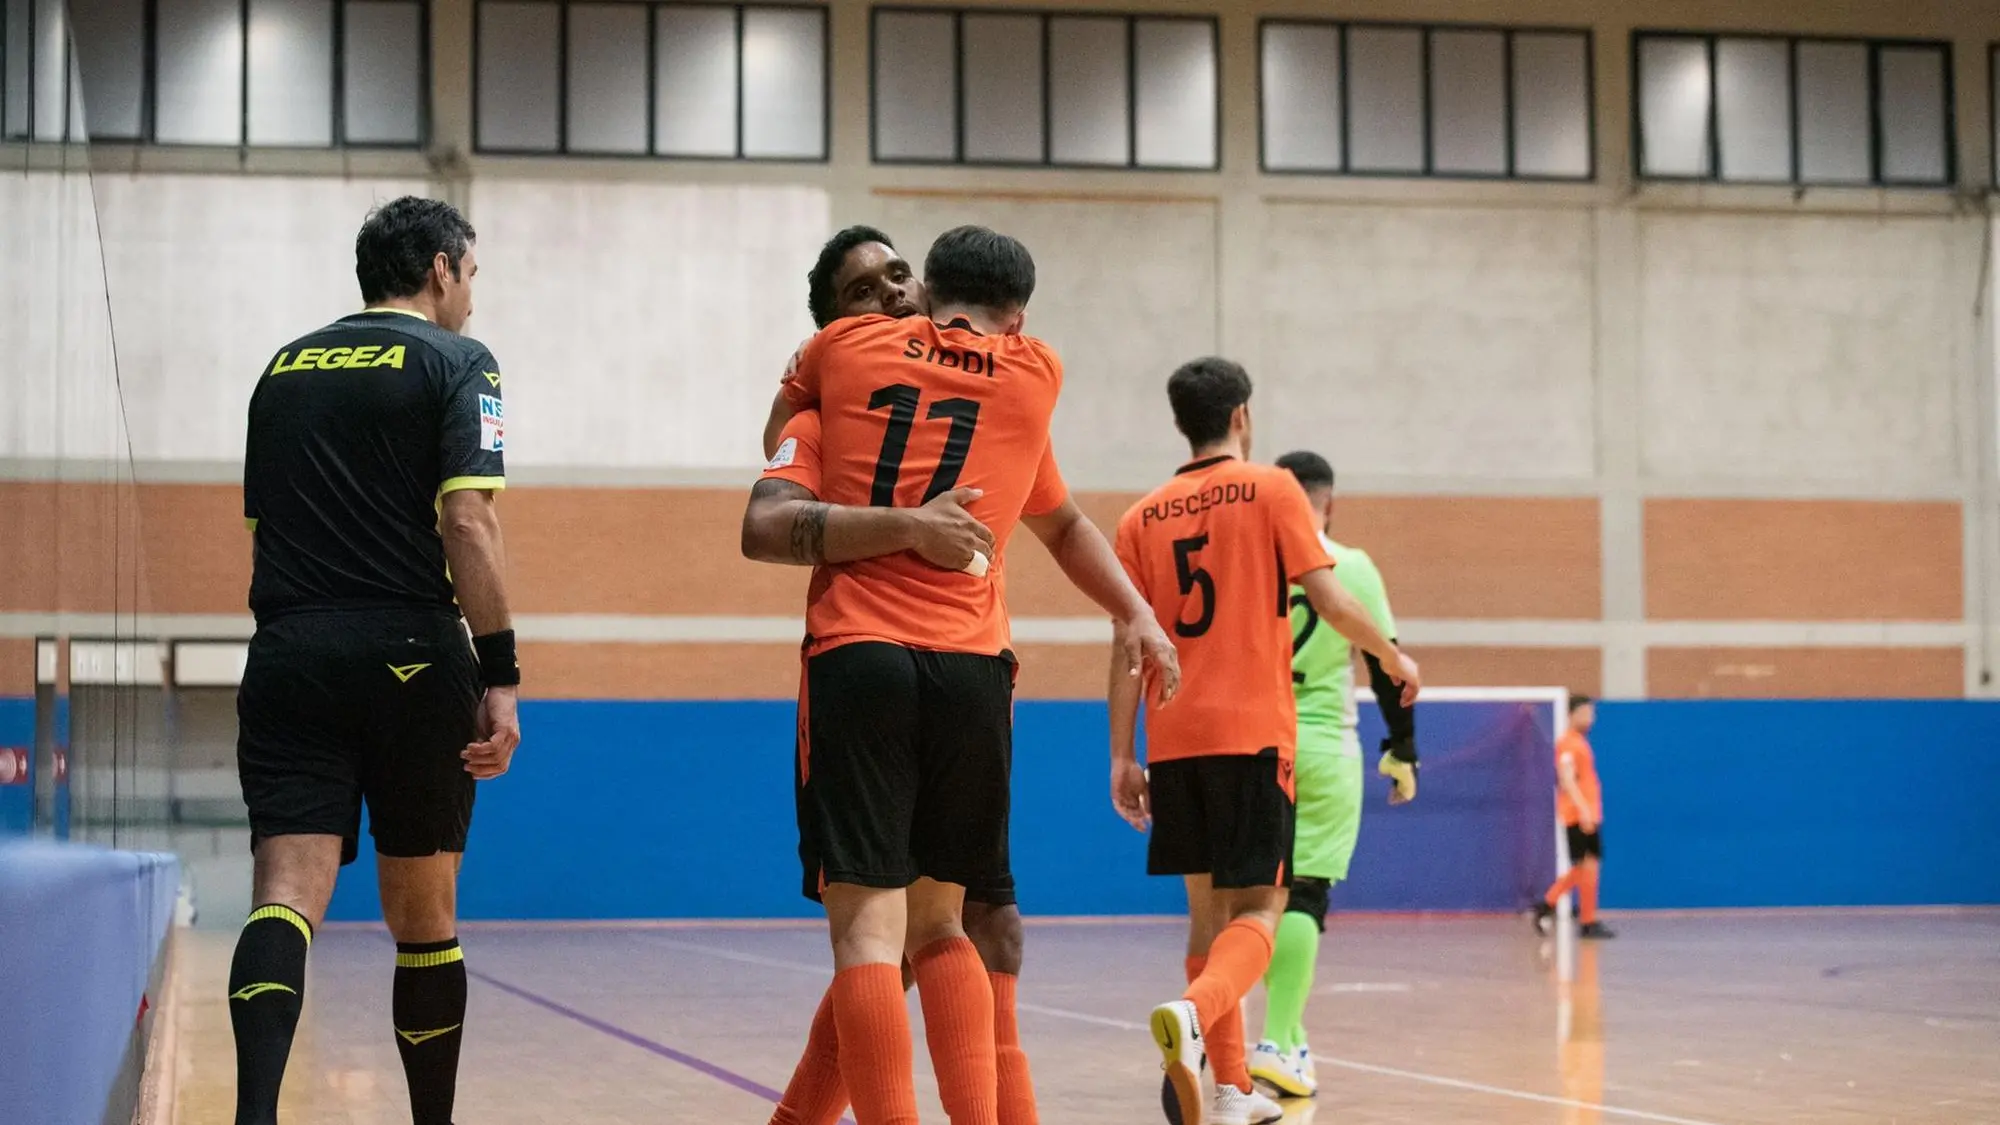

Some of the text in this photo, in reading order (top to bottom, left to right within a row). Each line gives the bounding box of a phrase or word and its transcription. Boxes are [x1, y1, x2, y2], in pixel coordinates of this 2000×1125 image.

[270, 345, 406, 376] LEGEA
[903, 338, 994, 377] SIDDI
[867, 383, 980, 507] 11
[1142, 483, 1257, 527] PUSCEDDU
[1172, 532, 1216, 638] 5
